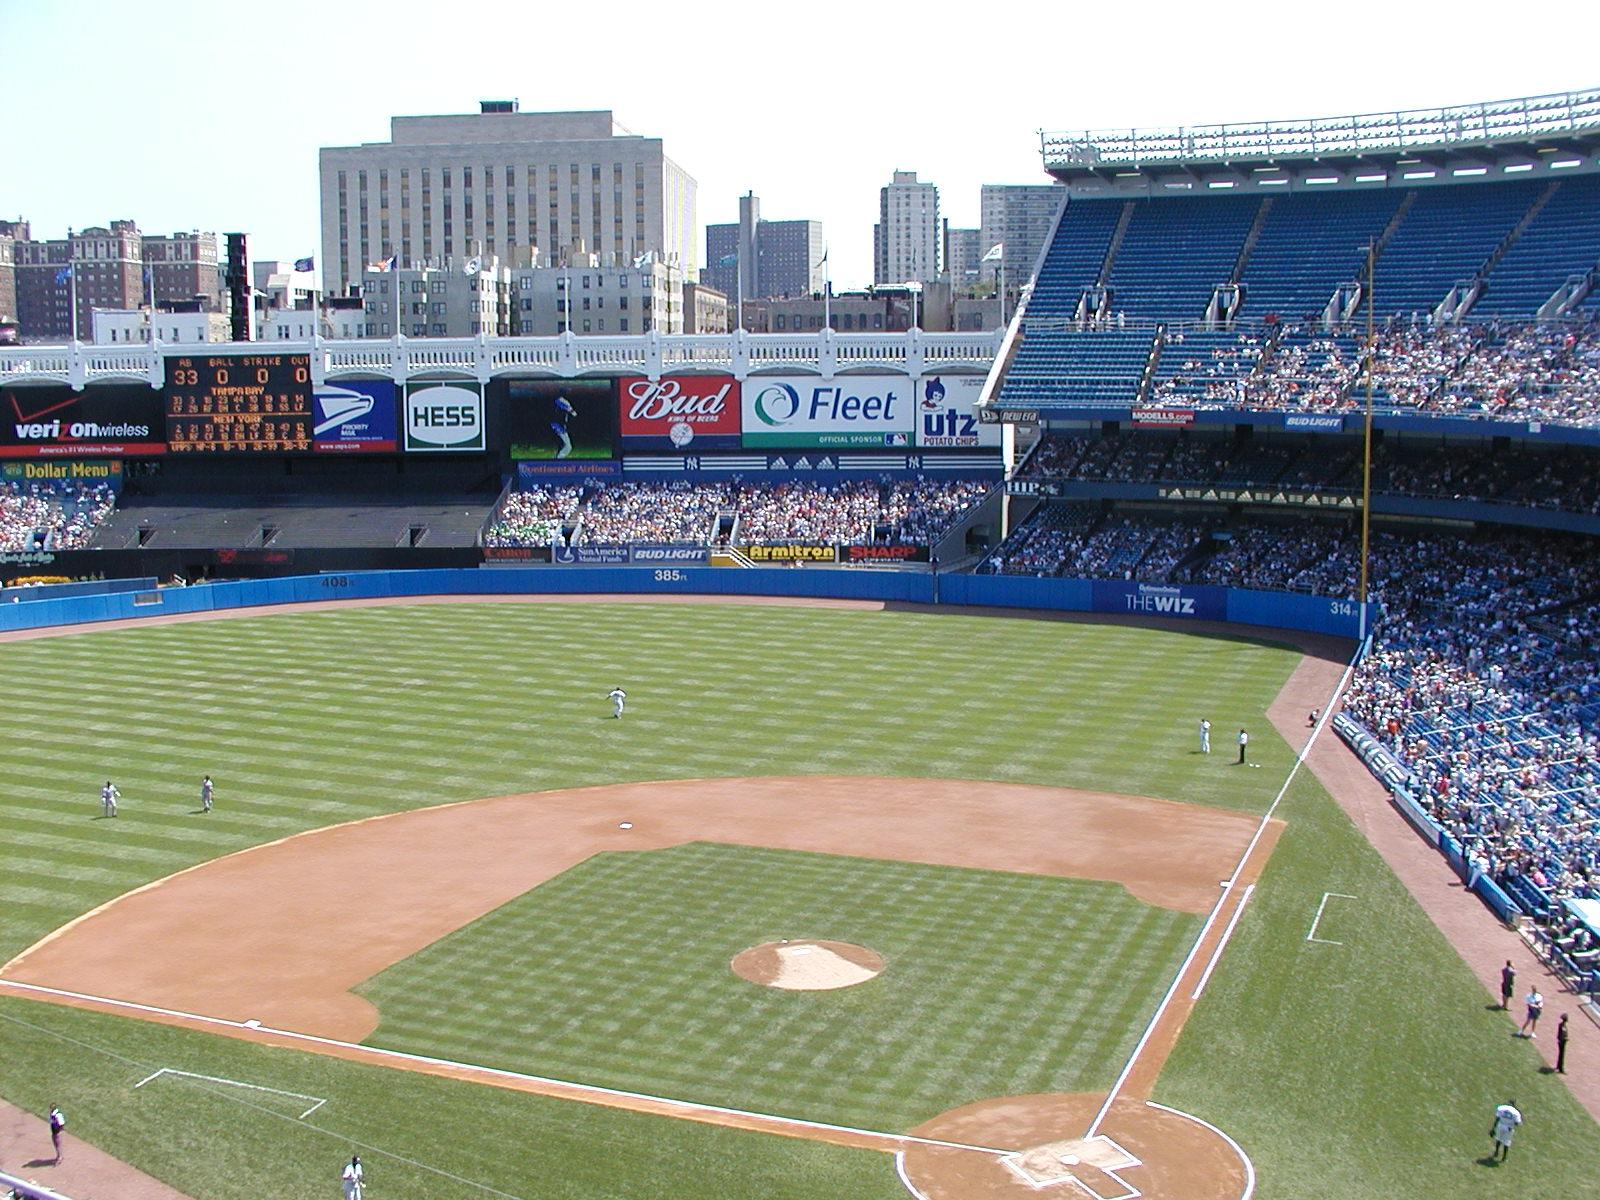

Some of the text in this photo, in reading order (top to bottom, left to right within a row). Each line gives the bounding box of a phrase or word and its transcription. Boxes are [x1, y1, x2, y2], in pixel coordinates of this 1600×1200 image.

[209, 358, 234, 367] BALL
[243, 357, 281, 366] STRIKE
[291, 357, 309, 366] OUT
[175, 367, 308, 385] 33 0 0 0
[211, 387, 244, 395] TAMPA
[628, 381, 732, 420] Bud
[808, 387, 897, 421] Fleet
[213, 416, 263, 424] NEW YORK
[413, 406, 475, 427] HESS
[1287, 417, 1340, 427] BUD LIGHT
[819, 436, 848, 444] OFFICIAL
[924, 437, 979, 446] POTATO CHIPS
[25, 463, 68, 478] Dollar
[71, 463, 109, 478] Menu
[521, 465, 614, 474] Continental Airlines
[1007, 482, 1039, 492] HIP
[483, 548, 532, 558] Canon
[578, 548, 627, 556] SunAmerica
[635, 550, 706, 559] BUD LIGHT
[750, 545, 834, 557] Armitron
[849, 546, 917, 558] SHARP
[654, 570, 680, 582] 385
[1125, 594, 1195, 614] THE WIZ
[1330, 601, 1351, 616] 314
